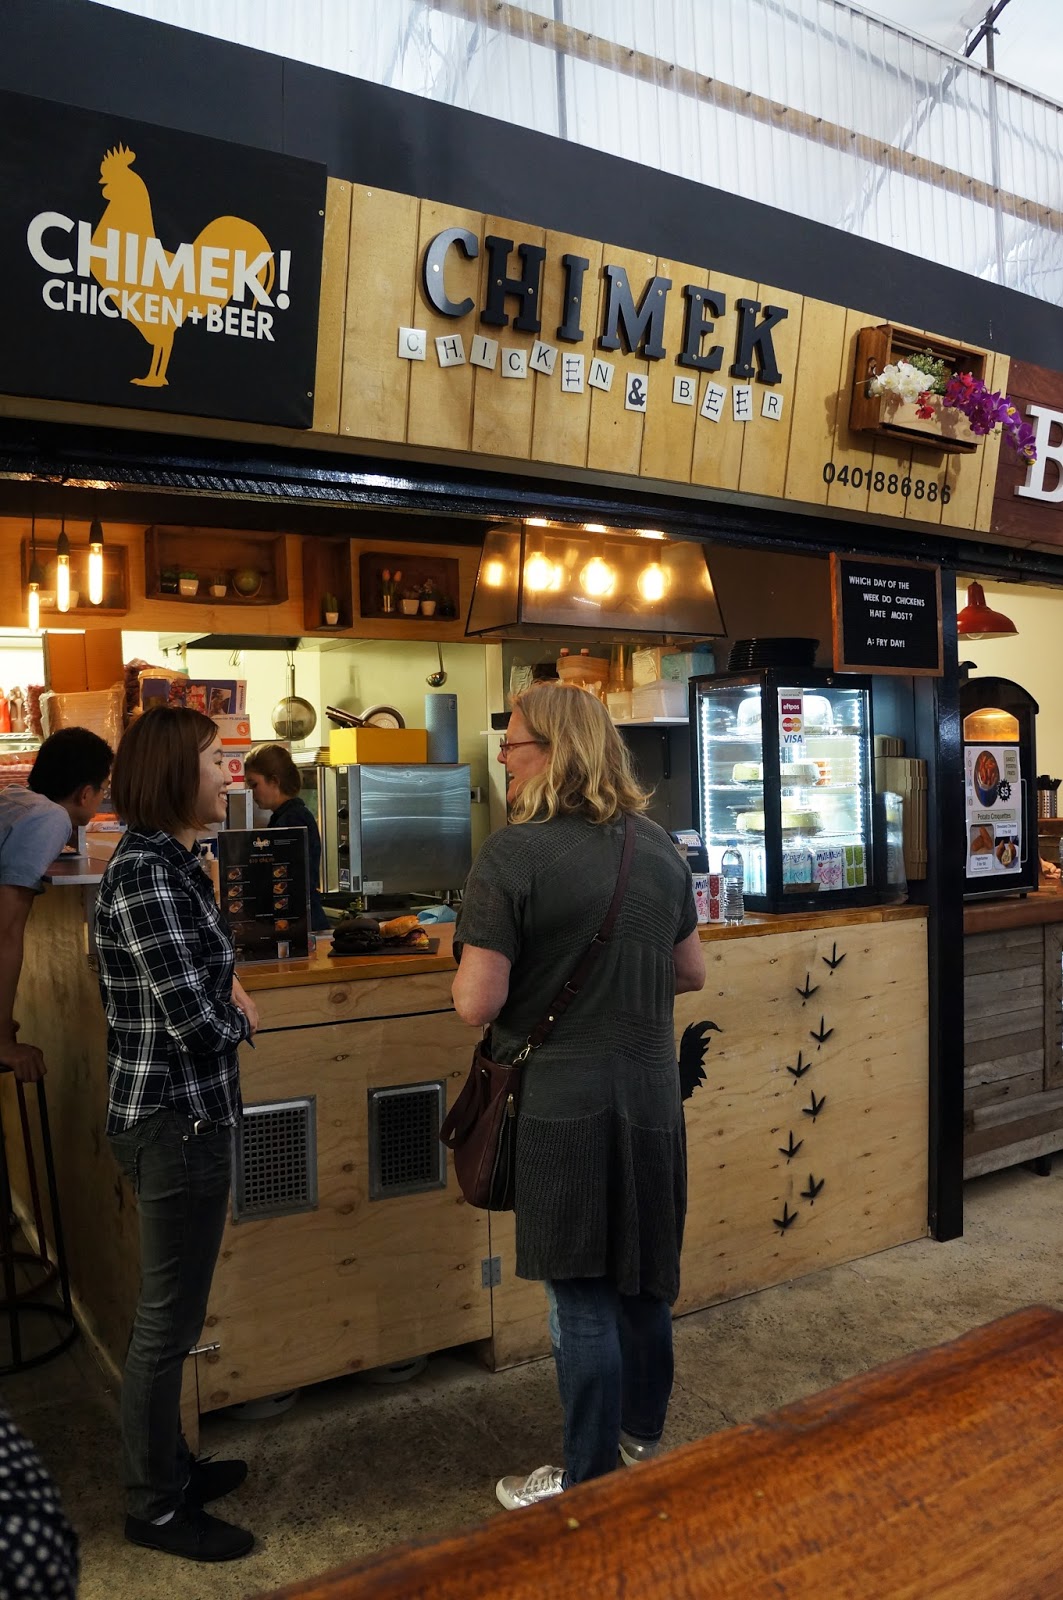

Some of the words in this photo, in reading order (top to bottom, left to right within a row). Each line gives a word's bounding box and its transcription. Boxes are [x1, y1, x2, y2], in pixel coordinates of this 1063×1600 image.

[27, 211, 291, 310] CHIMEK!
[423, 227, 789, 385] CHIMEK
[403, 330, 612, 390] CHICKEN
[628, 378, 647, 408] &
[678, 380, 780, 416] BEER
[822, 462, 951, 504] 0401886886
[848, 575, 872, 586] WHICH
[873, 578, 887, 588] DAY
[887, 580, 897, 588] OF
[898, 581, 910, 590] THE
[863, 593, 880, 602] WEEK
[881, 595, 892, 603] DO
[895, 596, 925, 607] CHICKENS
[869, 609, 886, 618] HATE
[890, 611, 913, 620] MOST?
[866, 637, 875, 646] A:
[876, 638, 888, 647] FRY
[890, 639, 906, 648] DAY!
[783, 703, 800, 711] eftpos
[783, 734, 803, 743] VISA
[1000, 787, 1009, 797] $5
[990, 812, 1012, 820] Croquettes
